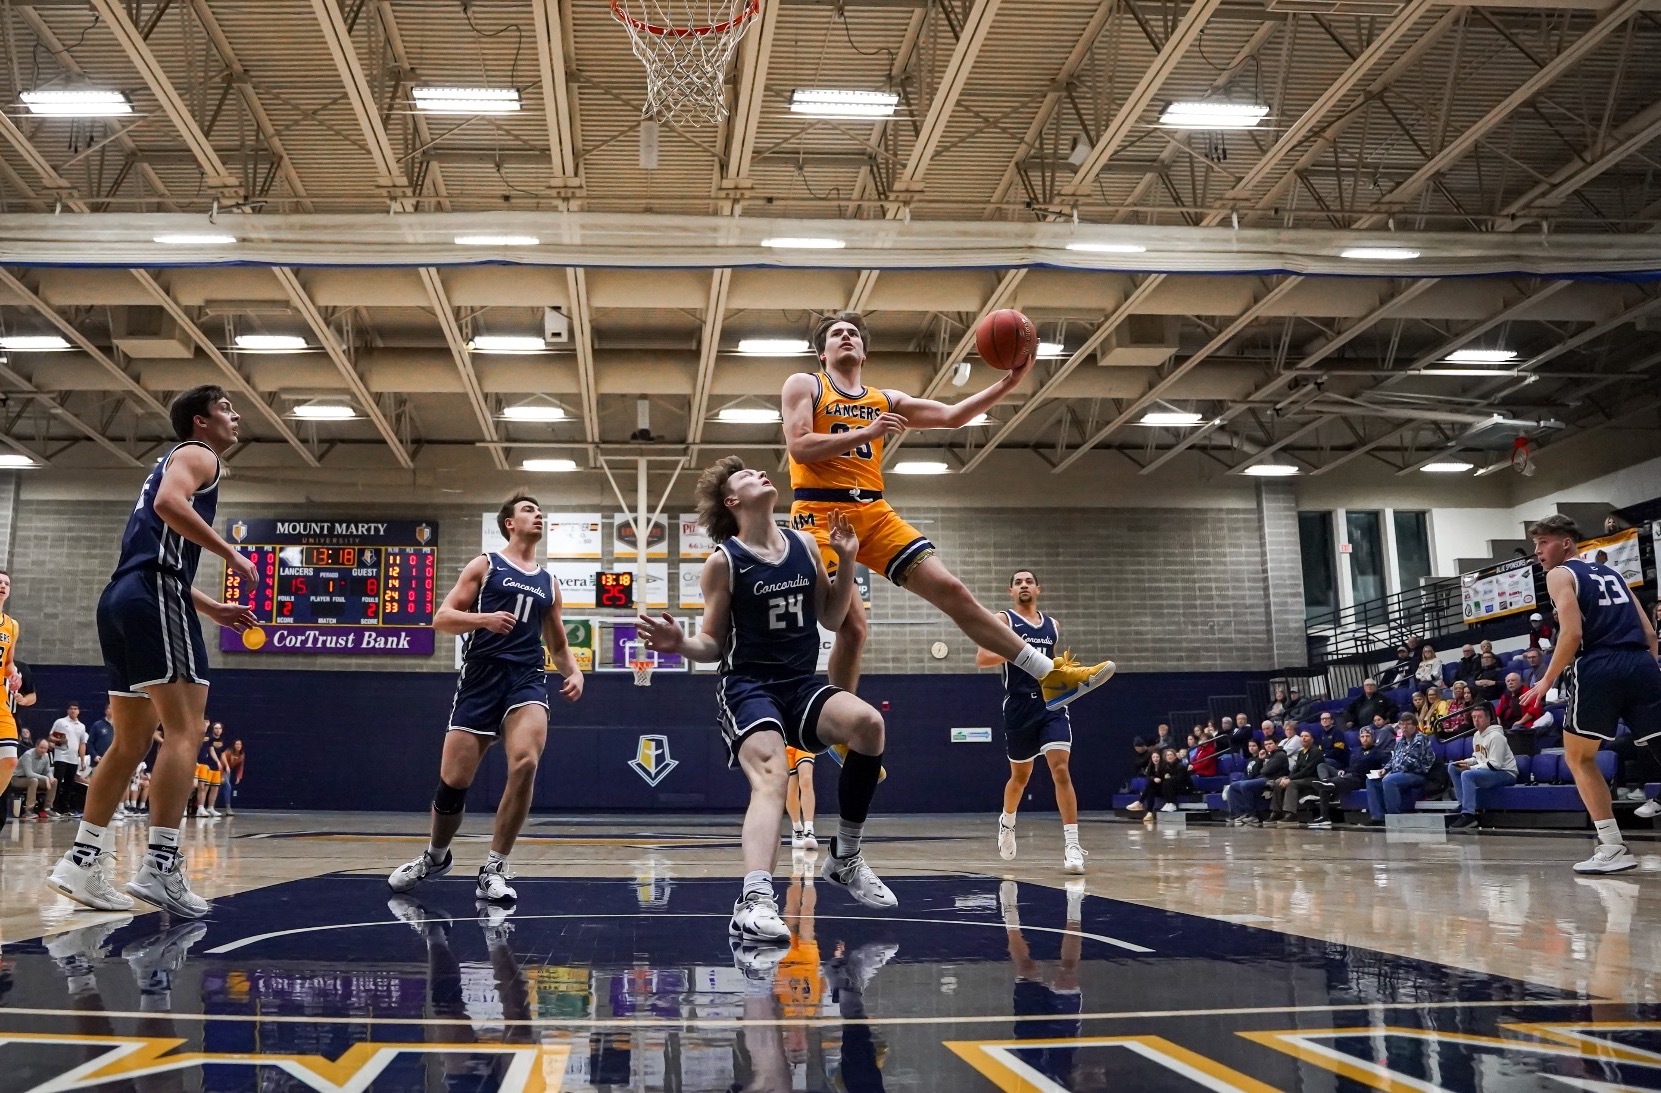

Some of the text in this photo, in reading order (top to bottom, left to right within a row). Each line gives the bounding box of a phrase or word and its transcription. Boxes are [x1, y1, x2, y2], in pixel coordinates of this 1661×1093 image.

[825, 403, 881, 420] LANCERS
[276, 522, 387, 536] MOUNT MARTY
[266, 553, 274, 563] 0
[313, 548, 354, 565] 13:18
[390, 555, 433, 566] 11 0 2
[266, 564, 274, 575] 0
[280, 568, 314, 576] LANCERS
[352, 568, 377, 577] GUEST
[389, 566, 400, 576] 12
[426, 567, 433, 577] 0
[226, 576, 240, 586] 22
[291, 578, 308, 594] 15
[388, 579, 400, 588] 14
[425, 579, 432, 588] 0
[558, 578, 587, 587] vera
[602, 574, 630, 586] 13:18
[754, 574, 810, 596] Concordia
[366, 578, 378, 595] 8
[502, 578, 546, 599] Concordia
[1588, 574, 1630, 606] 33
[226, 588, 240, 598] 23
[385, 590, 432, 601] 24 0 3
[602, 586, 626, 604] 25
[264, 600, 272, 610] 0
[284, 602, 292, 616] 2
[368, 603, 376, 616] 2
[386, 602, 432, 613] 33 0 3
[514, 594, 534, 623] 11
[768, 594, 804, 630] 24
[273, 630, 410, 648] CorTrust Bank
[1022, 634, 1054, 645] Concordia
